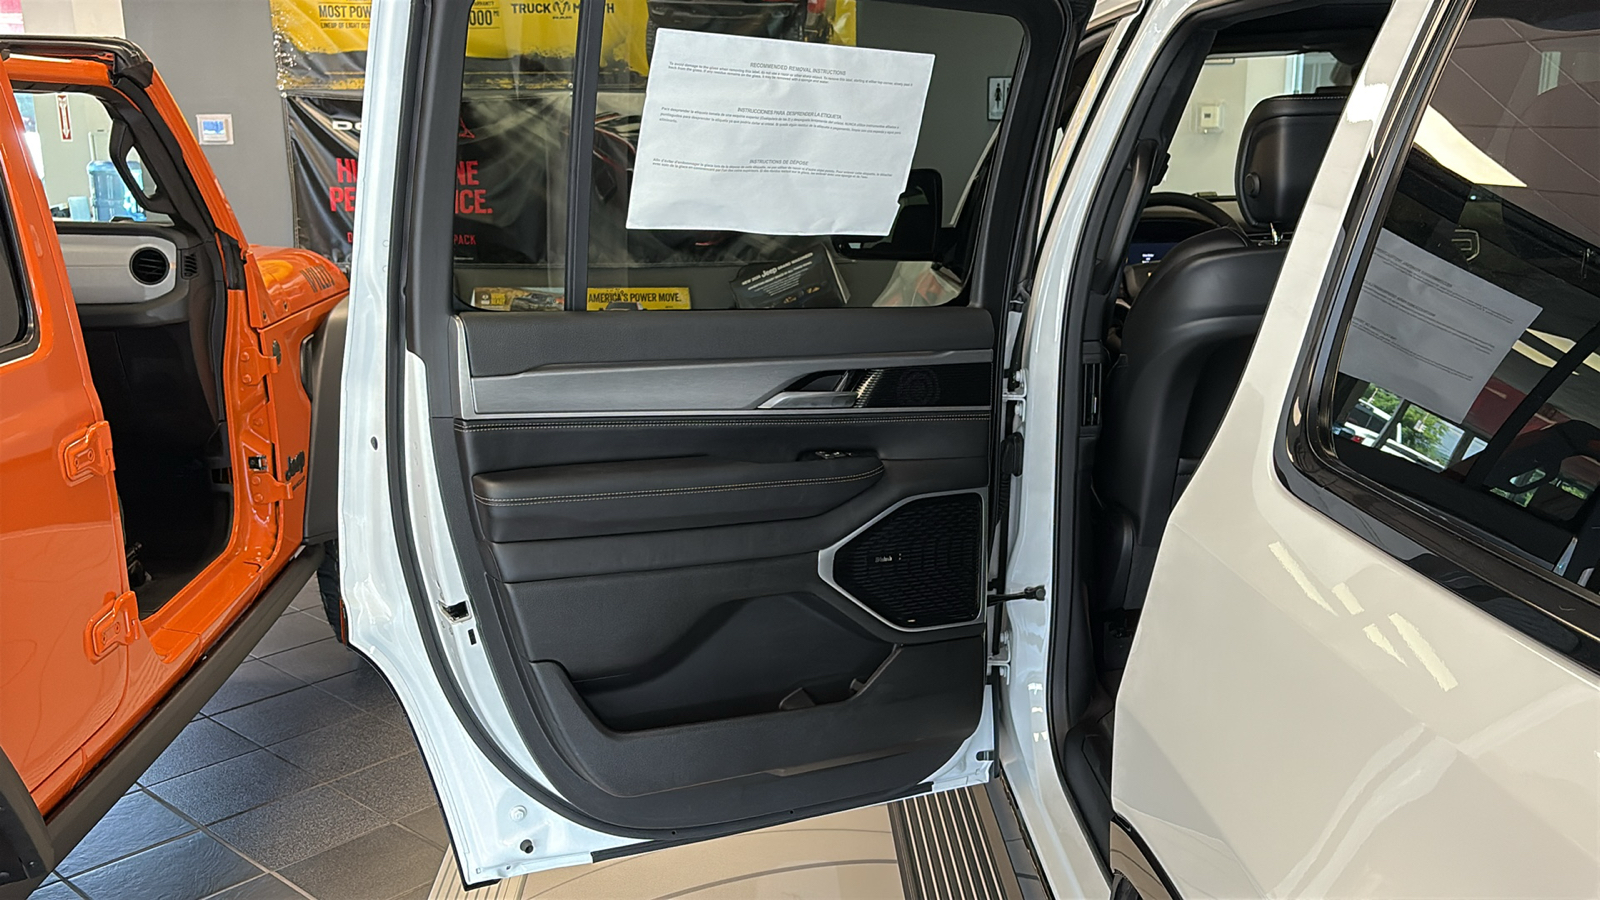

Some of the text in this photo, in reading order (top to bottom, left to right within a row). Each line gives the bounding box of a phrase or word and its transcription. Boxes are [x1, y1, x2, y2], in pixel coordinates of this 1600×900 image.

[318, 5, 347, 18] MOST
[511, 3, 552, 14] TRUCK
[750, 62, 788, 70] RECOMMENDED
[812, 67, 846, 76] INSTRUCTIONS
[761, 267, 777, 278] Jeep
[588, 291, 628, 303] AMERICA'S
[630, 293, 656, 302] POWER
